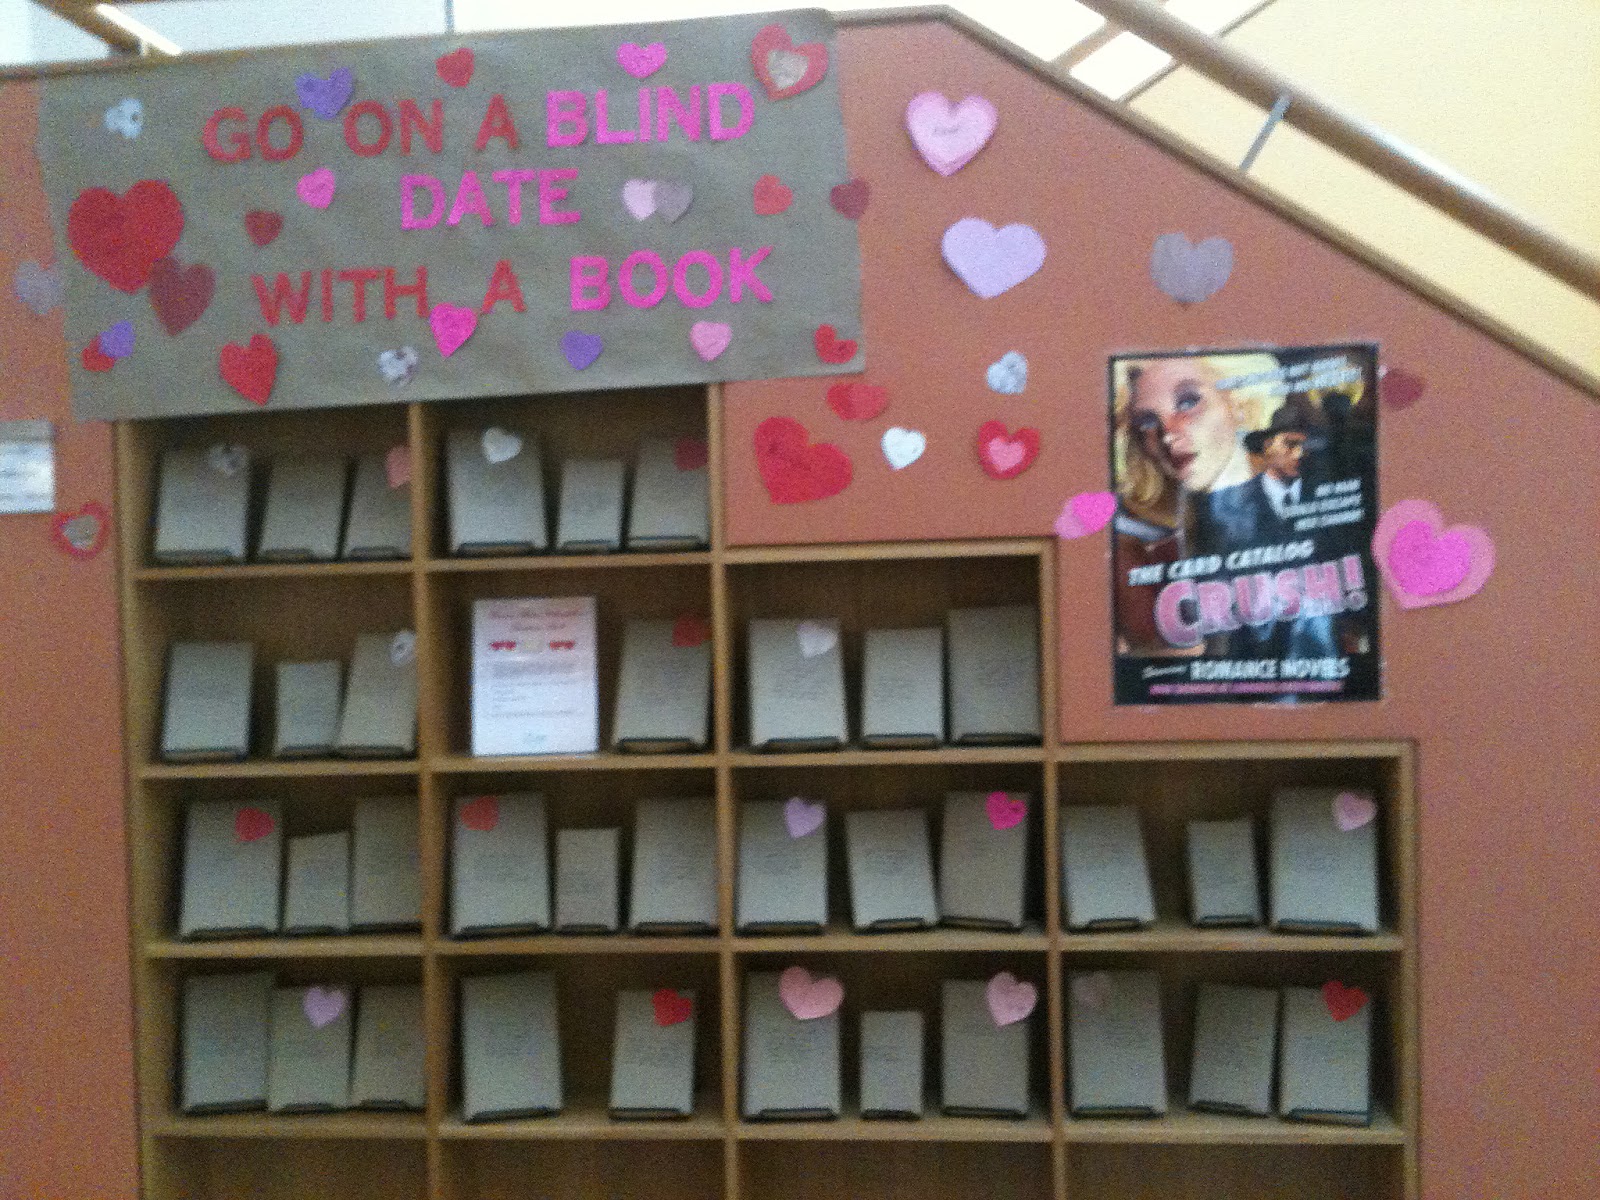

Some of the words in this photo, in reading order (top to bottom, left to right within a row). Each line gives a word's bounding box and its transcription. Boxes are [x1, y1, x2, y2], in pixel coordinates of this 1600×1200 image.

[202, 106, 304, 163] GO
[343, 100, 444, 157] ON
[474, 94, 519, 152] A
[546, 82, 756, 148] BLIND
[400, 168, 581, 230] DATE
[250, 266, 429, 326] WITH
[481, 259, 527, 314] A
[570, 246, 774, 311] BOOK
[1225, 539, 1315, 570] CATALOG
[1154, 554, 1367, 648] CRUSH!
[1190, 657, 1277, 681] ROMANCE
